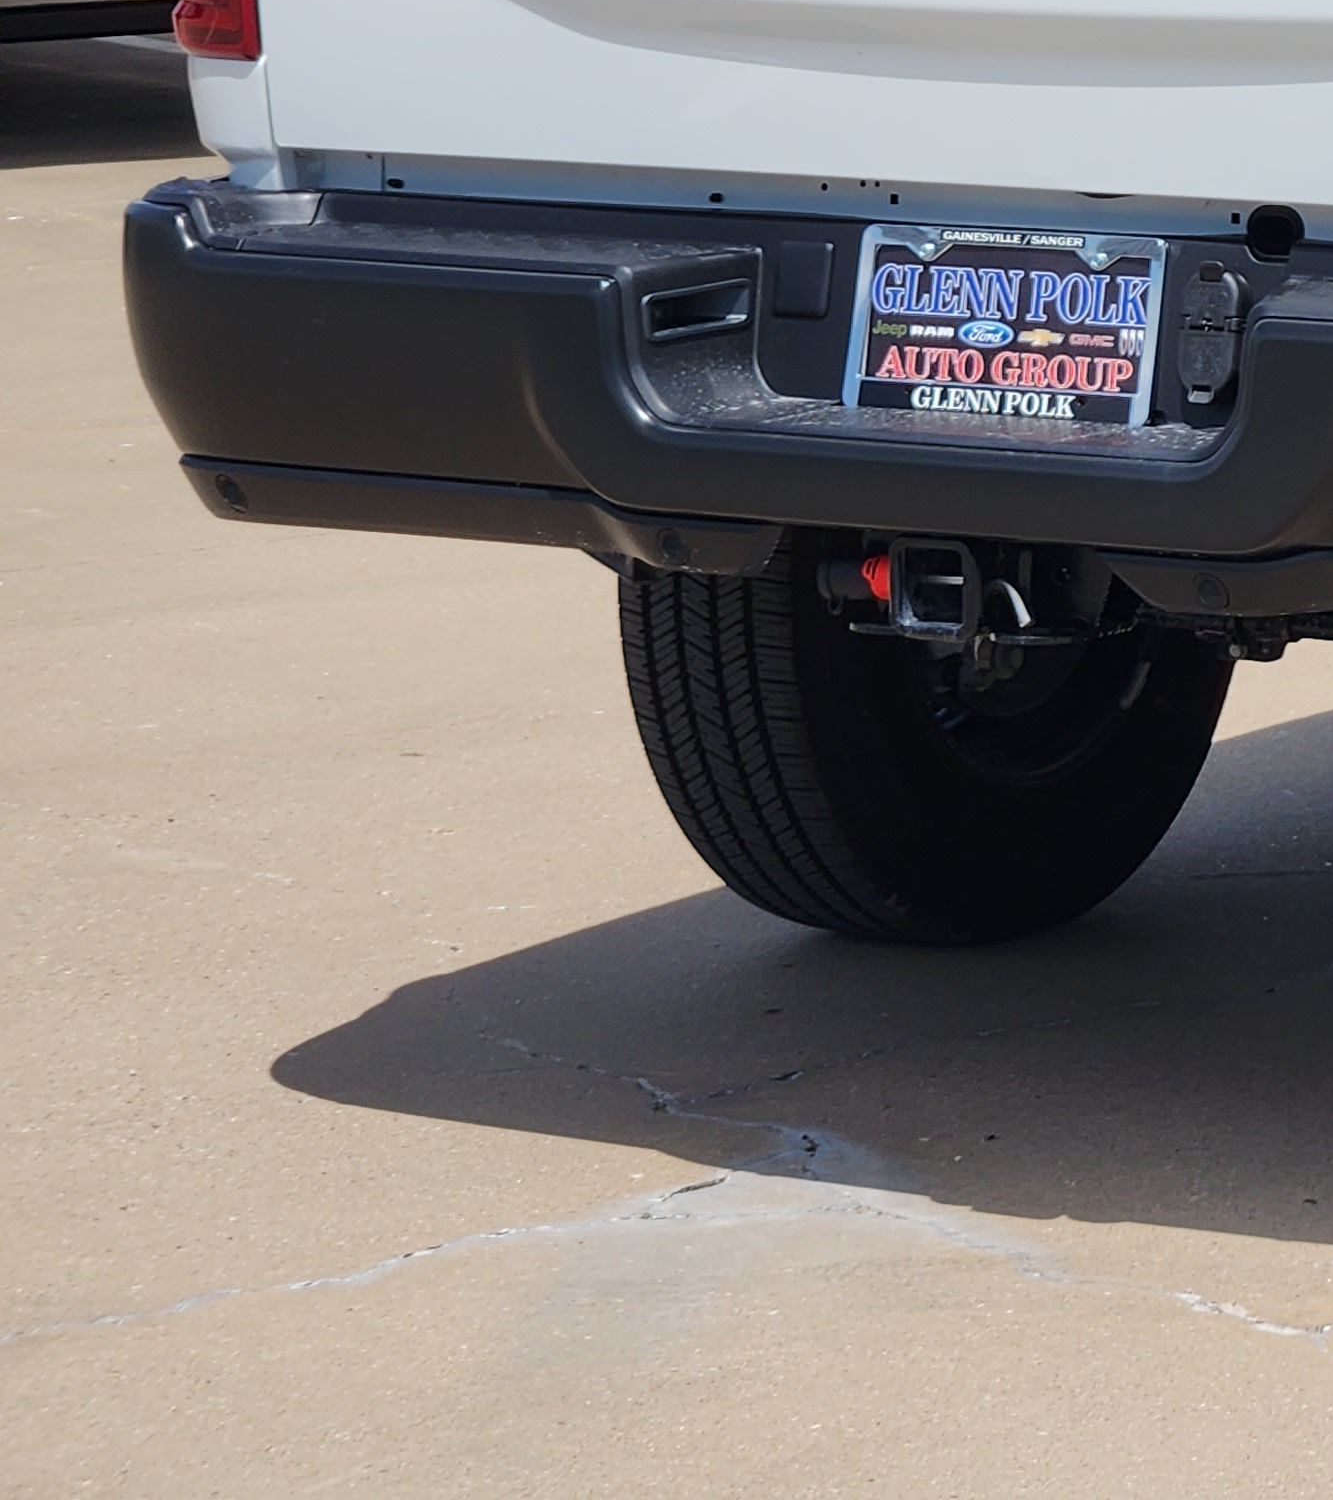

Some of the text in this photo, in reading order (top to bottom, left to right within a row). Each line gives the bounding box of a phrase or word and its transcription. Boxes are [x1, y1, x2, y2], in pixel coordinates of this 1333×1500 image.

[943, 230, 1022, 245] GAINESVILLE
[1031, 235, 1084, 248] SANGER
[873, 263, 1151, 326] GLENN POLK
[872, 320, 1116, 348] Jeep RAM Ford GMC
[875, 345, 1135, 392] AUTO GROUP
[910, 385, 1077, 419] GLENN POLK
